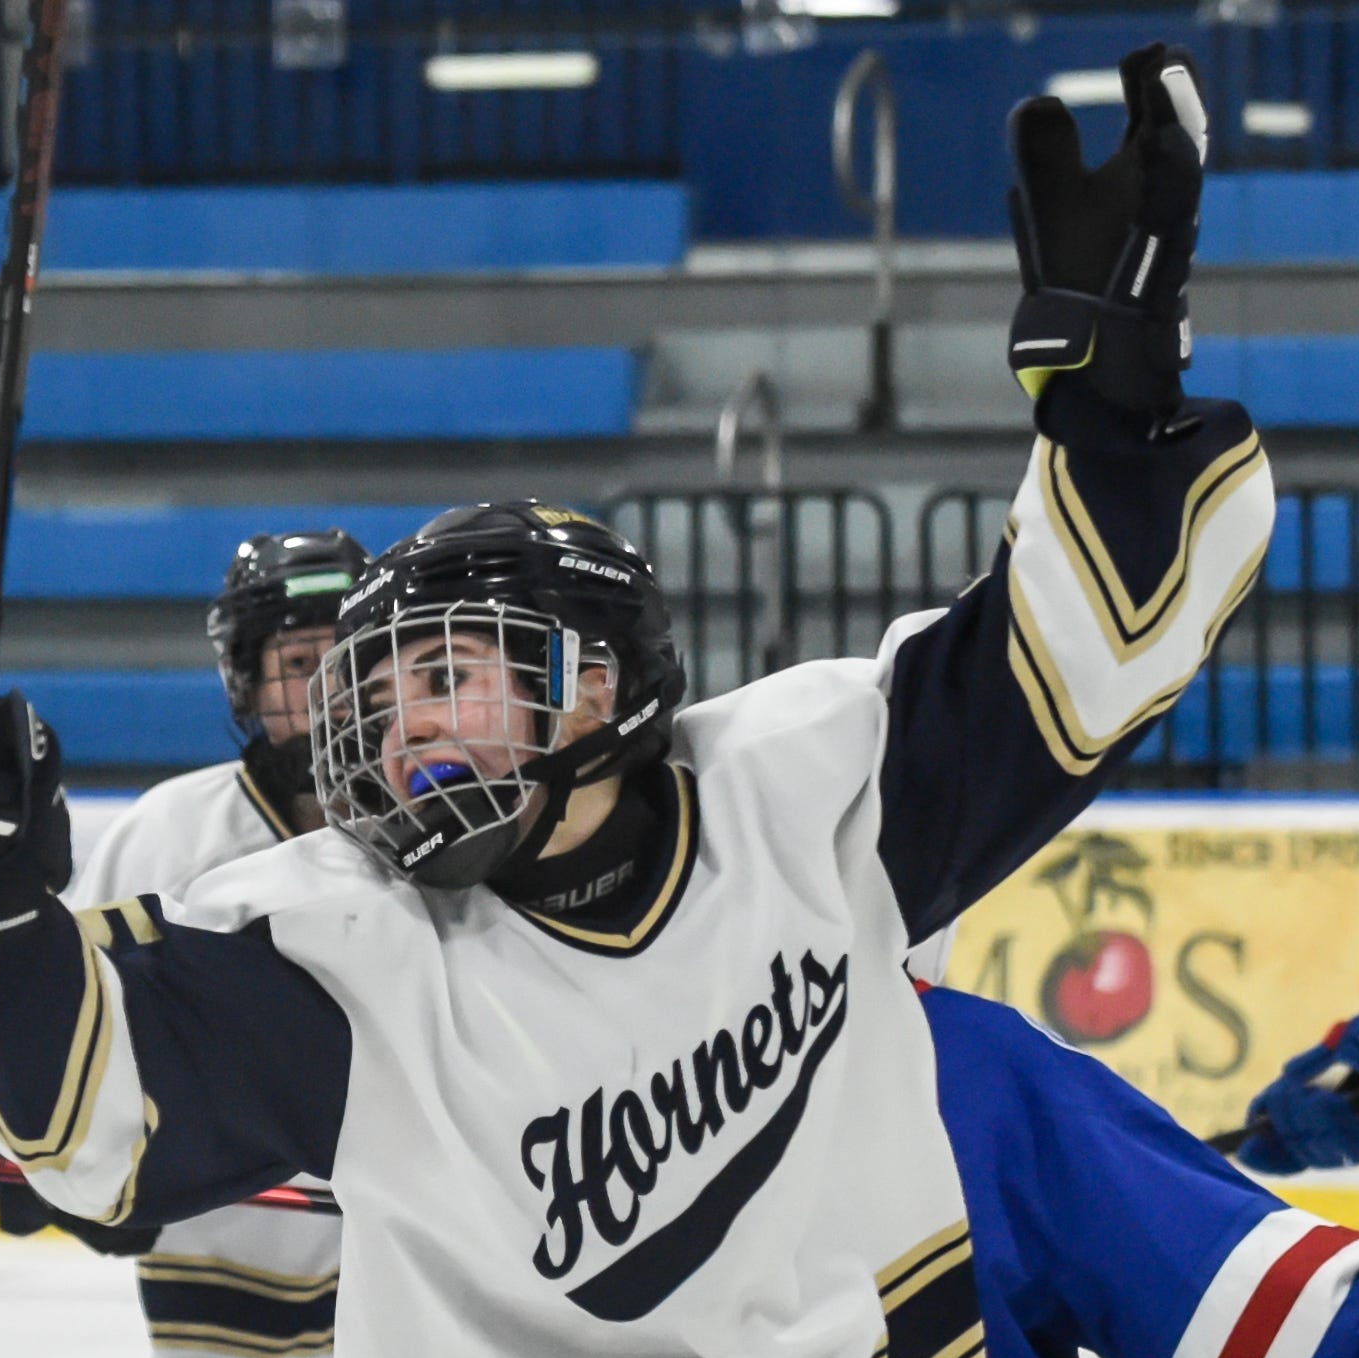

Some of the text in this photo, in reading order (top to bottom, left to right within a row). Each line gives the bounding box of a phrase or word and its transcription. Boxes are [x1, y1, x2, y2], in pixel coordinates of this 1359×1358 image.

[558, 556, 631, 585] BAUER
[401, 832, 444, 868] AUER
[520, 948, 850, 1282] Hornets
